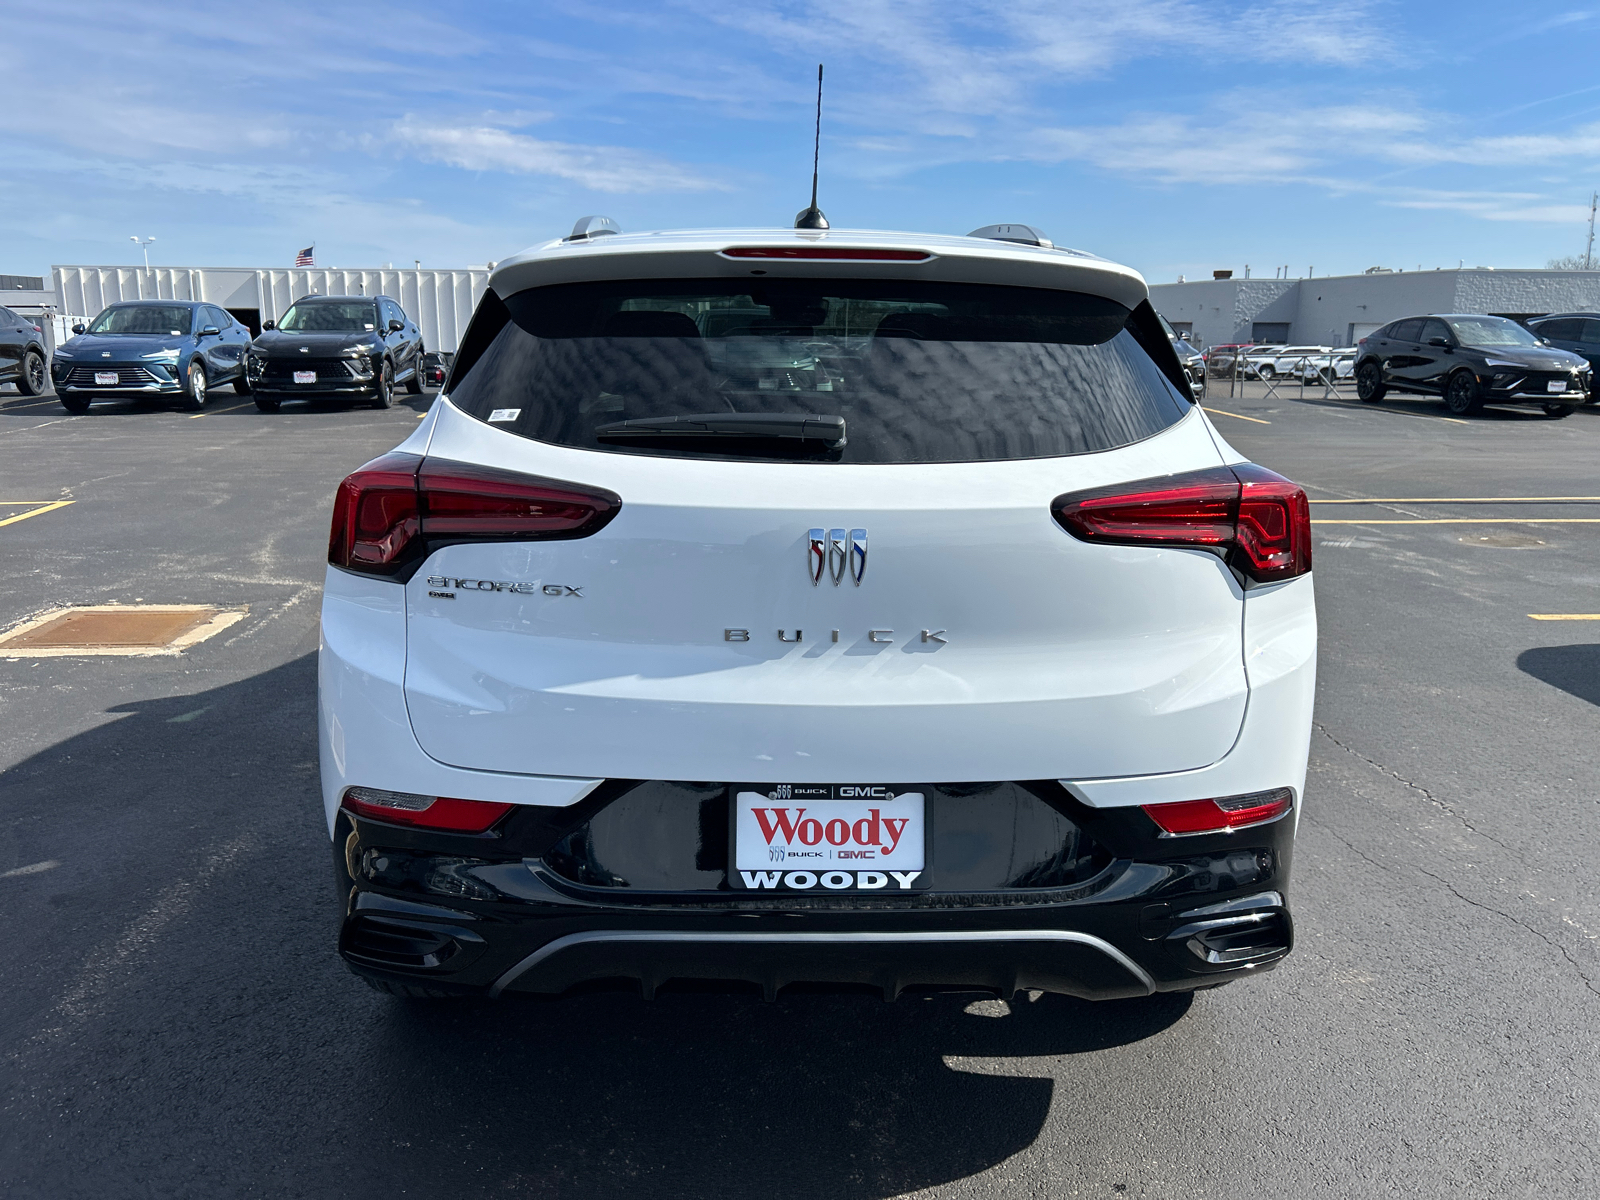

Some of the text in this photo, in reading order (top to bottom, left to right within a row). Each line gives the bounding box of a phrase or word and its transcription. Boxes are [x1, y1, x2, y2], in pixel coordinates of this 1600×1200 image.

[427, 575, 584, 598] ENCORE GX
[724, 629, 949, 643] BUICK
[839, 786, 886, 797] GMC
[751, 808, 910, 855] Woody
[837, 850, 876, 859] GMC
[740, 871, 922, 889] WOODY
